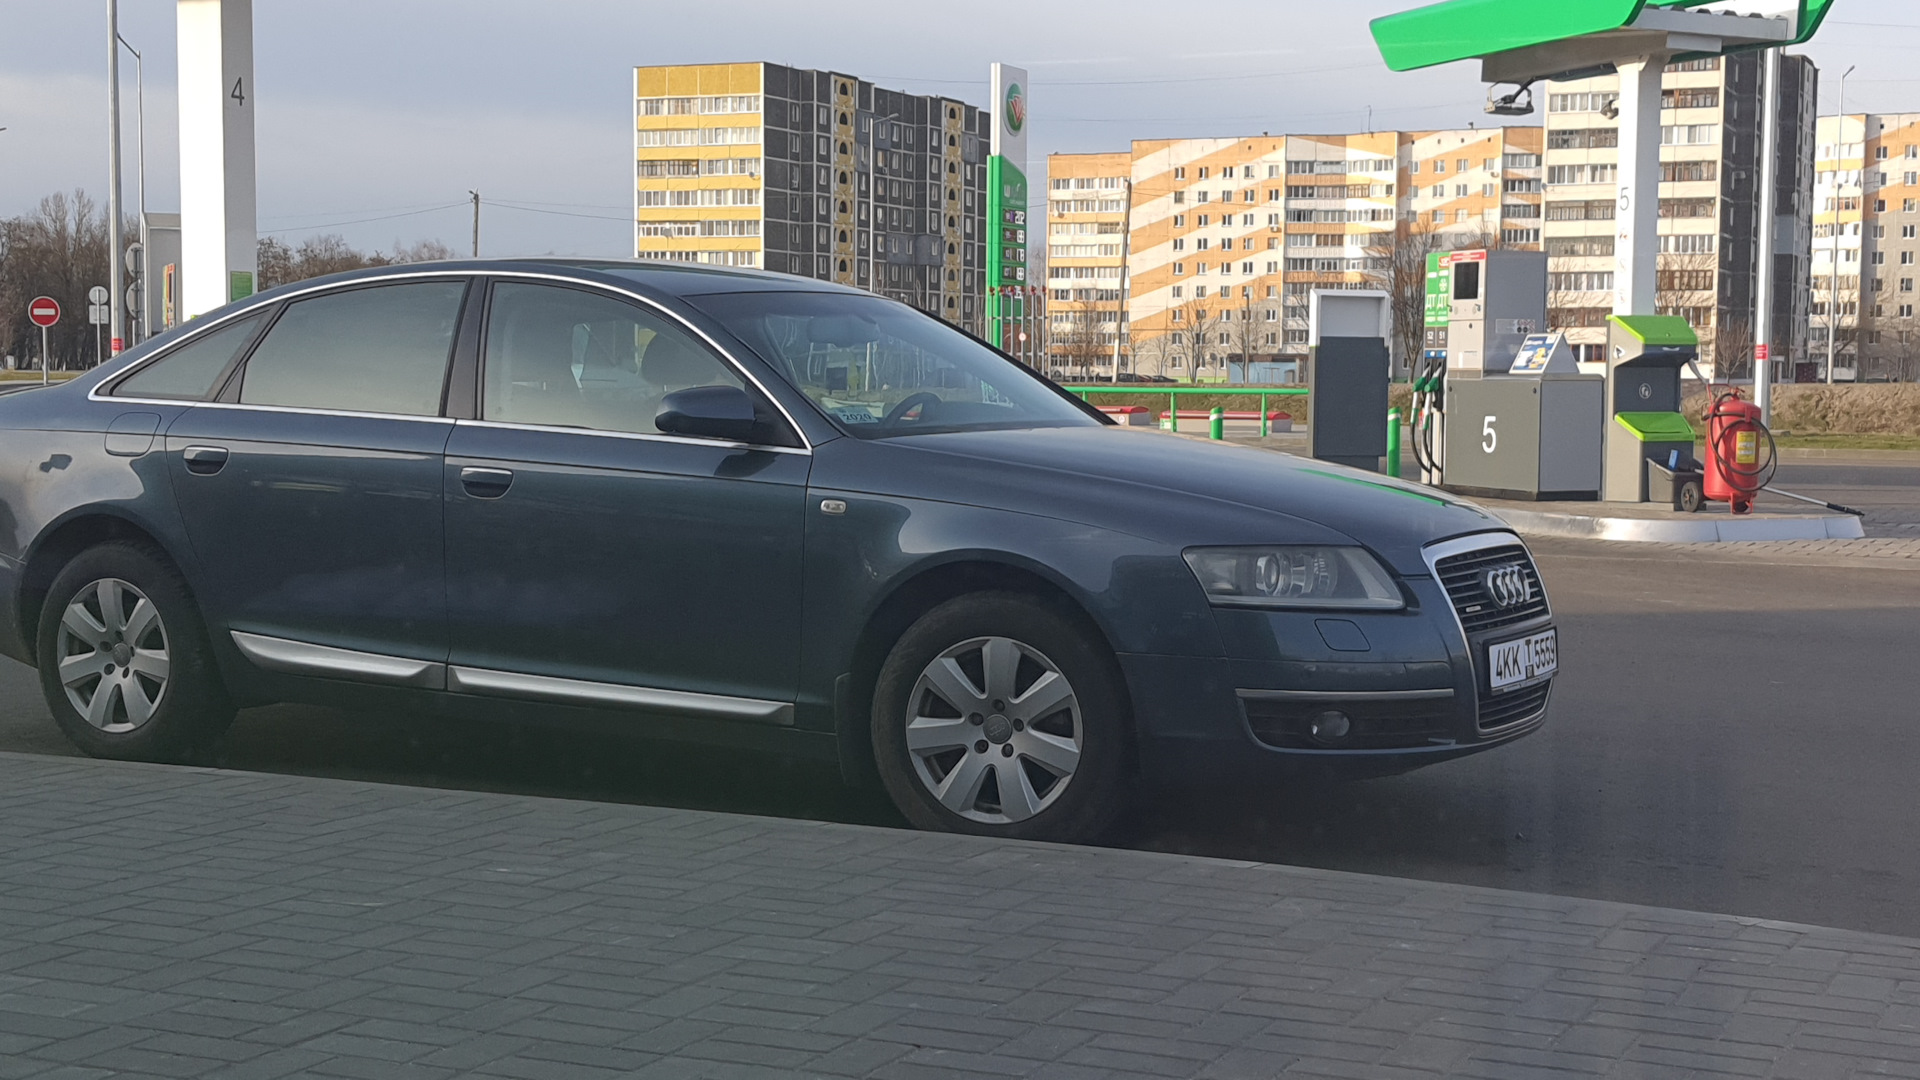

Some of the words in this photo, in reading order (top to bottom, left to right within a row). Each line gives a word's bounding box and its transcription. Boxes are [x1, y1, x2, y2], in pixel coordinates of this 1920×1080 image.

[231, 76, 245, 106] 4
[1619, 187, 1630, 211] 5
[842, 413, 872, 421] 2020
[1482, 415, 1496, 453] 5
[1495, 644, 1522, 680] 4KK
[1533, 634, 1555, 670] 5559
